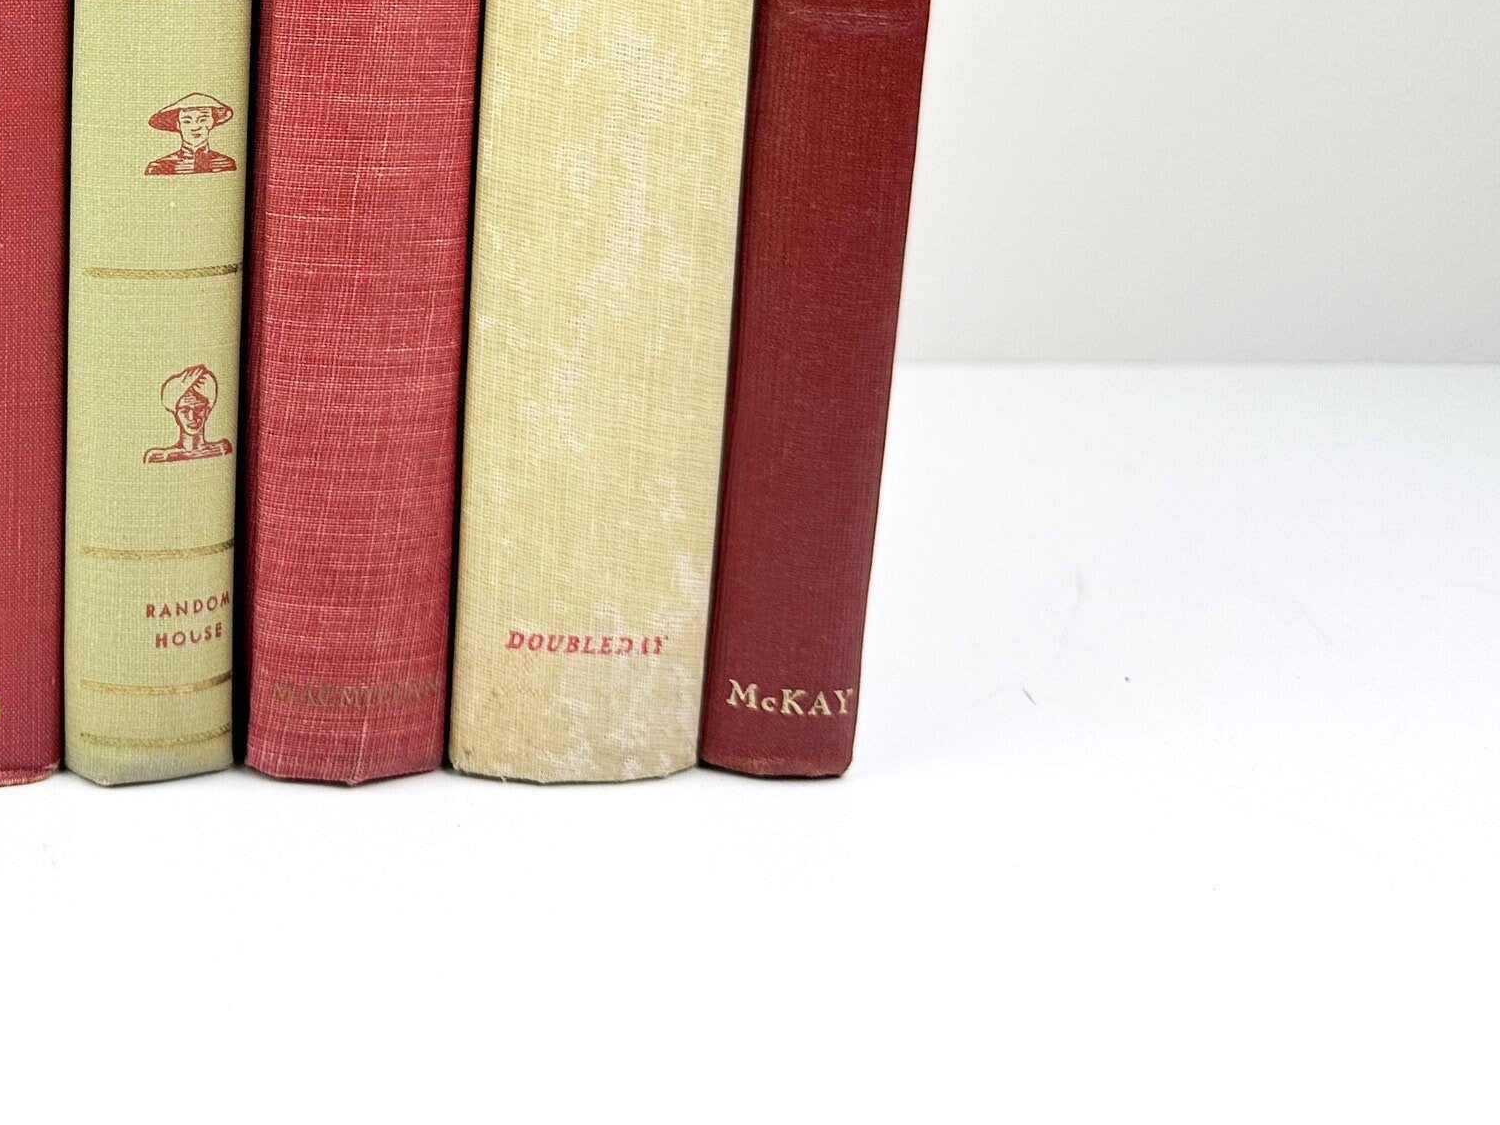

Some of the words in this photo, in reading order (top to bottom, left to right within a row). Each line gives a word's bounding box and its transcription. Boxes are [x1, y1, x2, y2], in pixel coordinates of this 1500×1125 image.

[145, 591, 231, 619] RANDOM
[155, 622, 223, 649] HOUSE
[726, 679, 853, 717] McKAY
